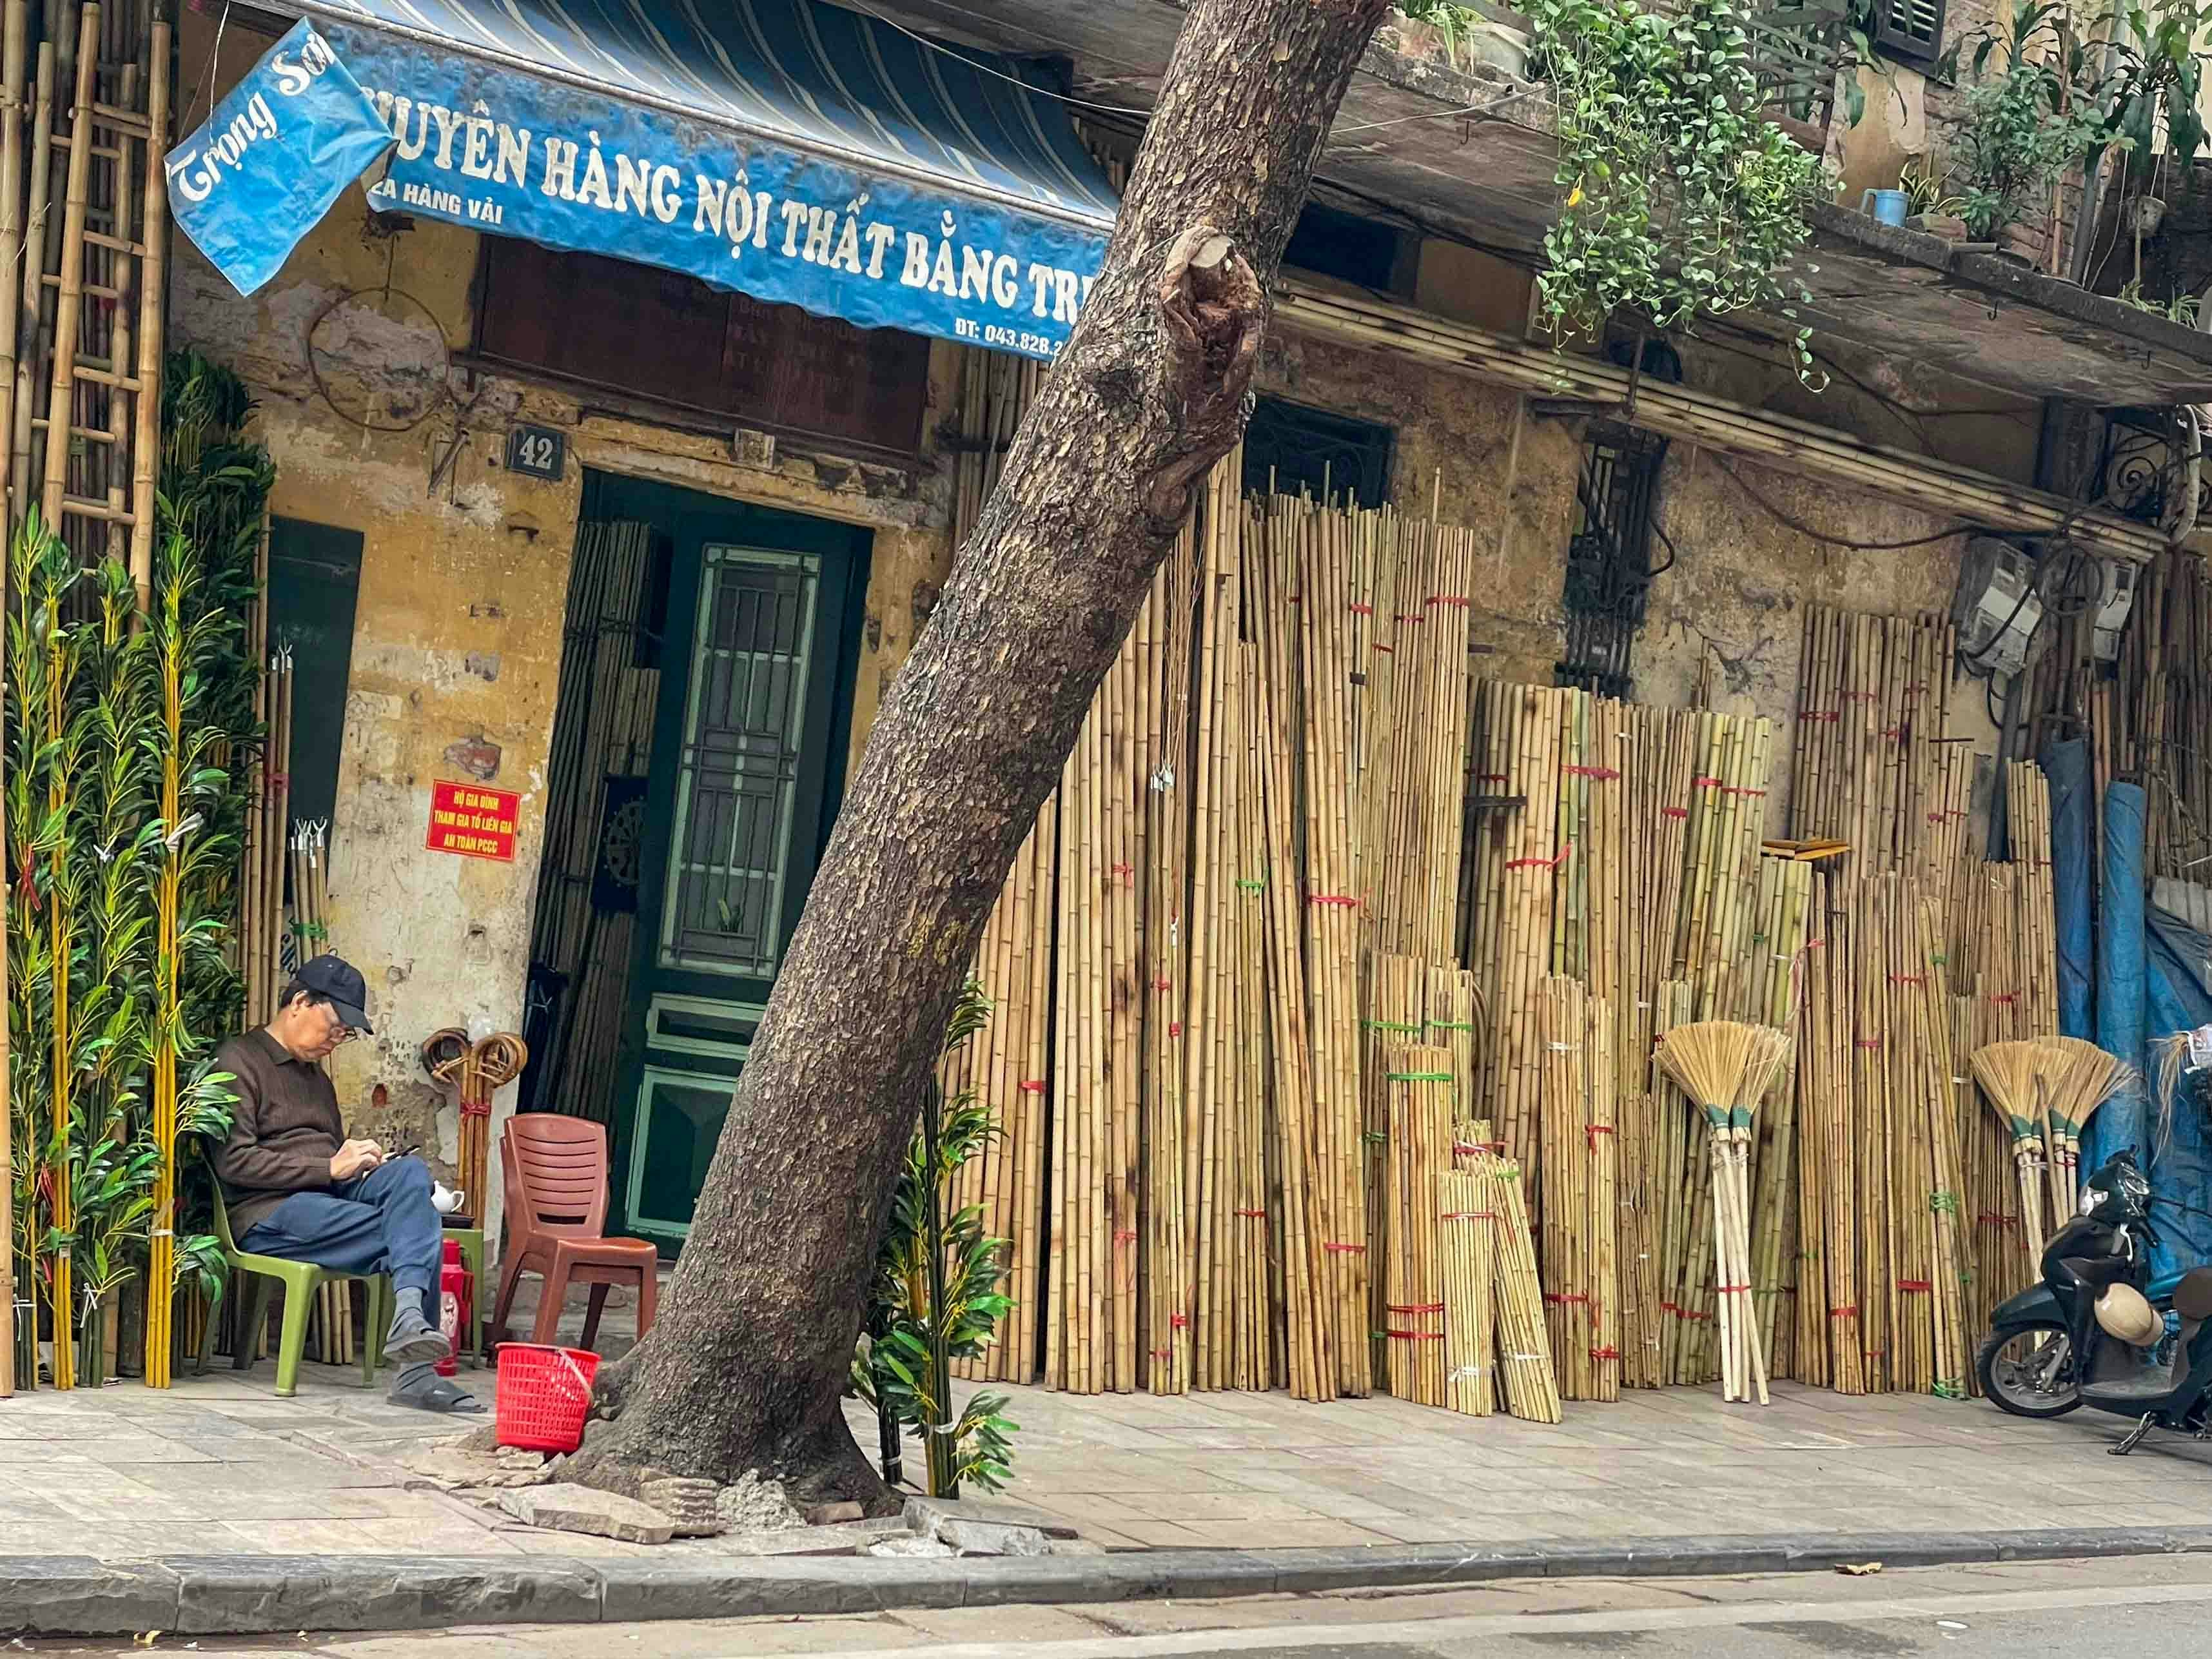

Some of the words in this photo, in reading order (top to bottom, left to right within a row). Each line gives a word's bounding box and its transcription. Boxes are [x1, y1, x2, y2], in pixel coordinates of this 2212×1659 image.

[170, 92, 277, 201] Trọng
[361, 86, 532, 189] UYÊN
[541, 130, 682, 222] HÀNG
[693, 168, 772, 259] NỘI
[781, 193, 895, 279] THẤT
[900, 210, 1018, 308] BẰNG
[403, 183, 462, 215] HÀNG
[468, 197, 503, 224] VẢI
[519, 435, 553, 469] 42
[465, 793, 478, 807] GIA
[434, 810, 455, 825] THAM
[456, 814, 469, 827] GIA
[500, 820, 512, 835] GIA
[444, 833, 455, 847] AN
[477, 839, 498, 854] PCCC
